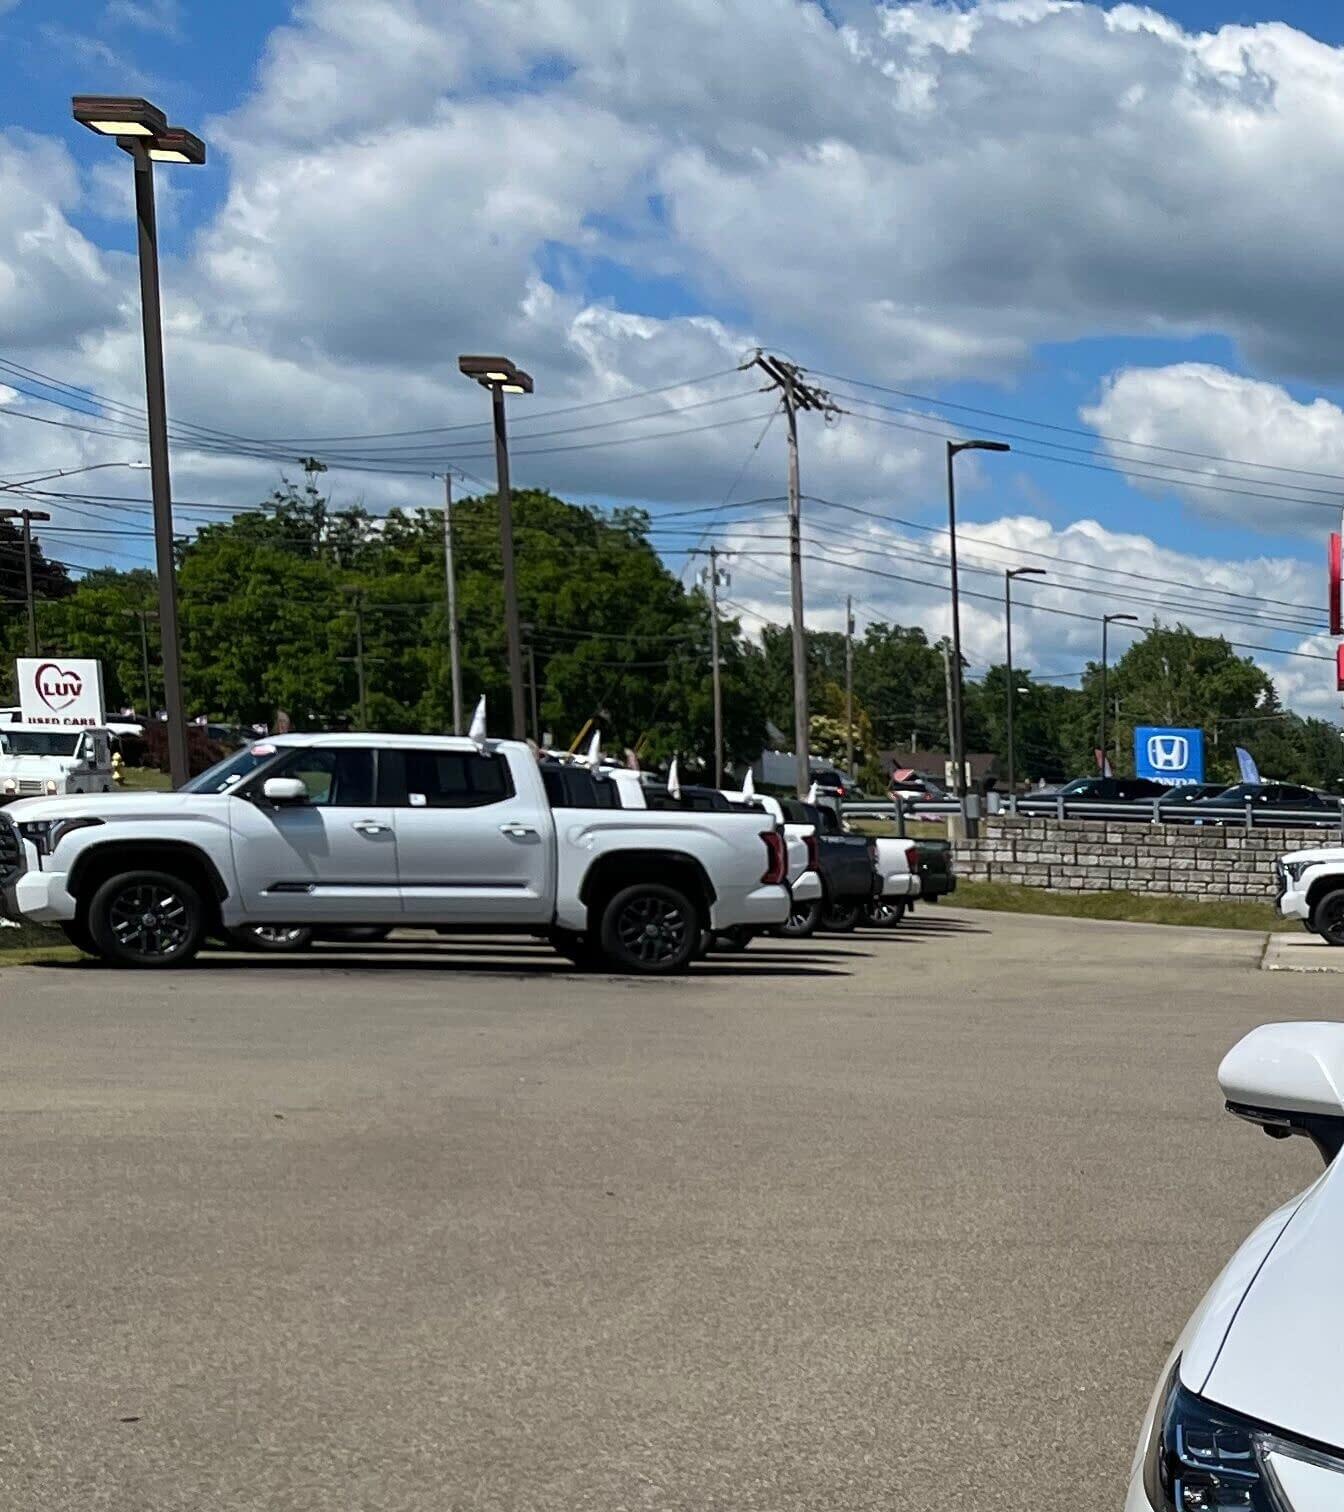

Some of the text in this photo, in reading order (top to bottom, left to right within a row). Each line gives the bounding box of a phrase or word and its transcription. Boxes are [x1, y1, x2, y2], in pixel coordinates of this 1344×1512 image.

[43, 683, 82, 696] LUV
[28, 717, 96, 726] USED CARS
